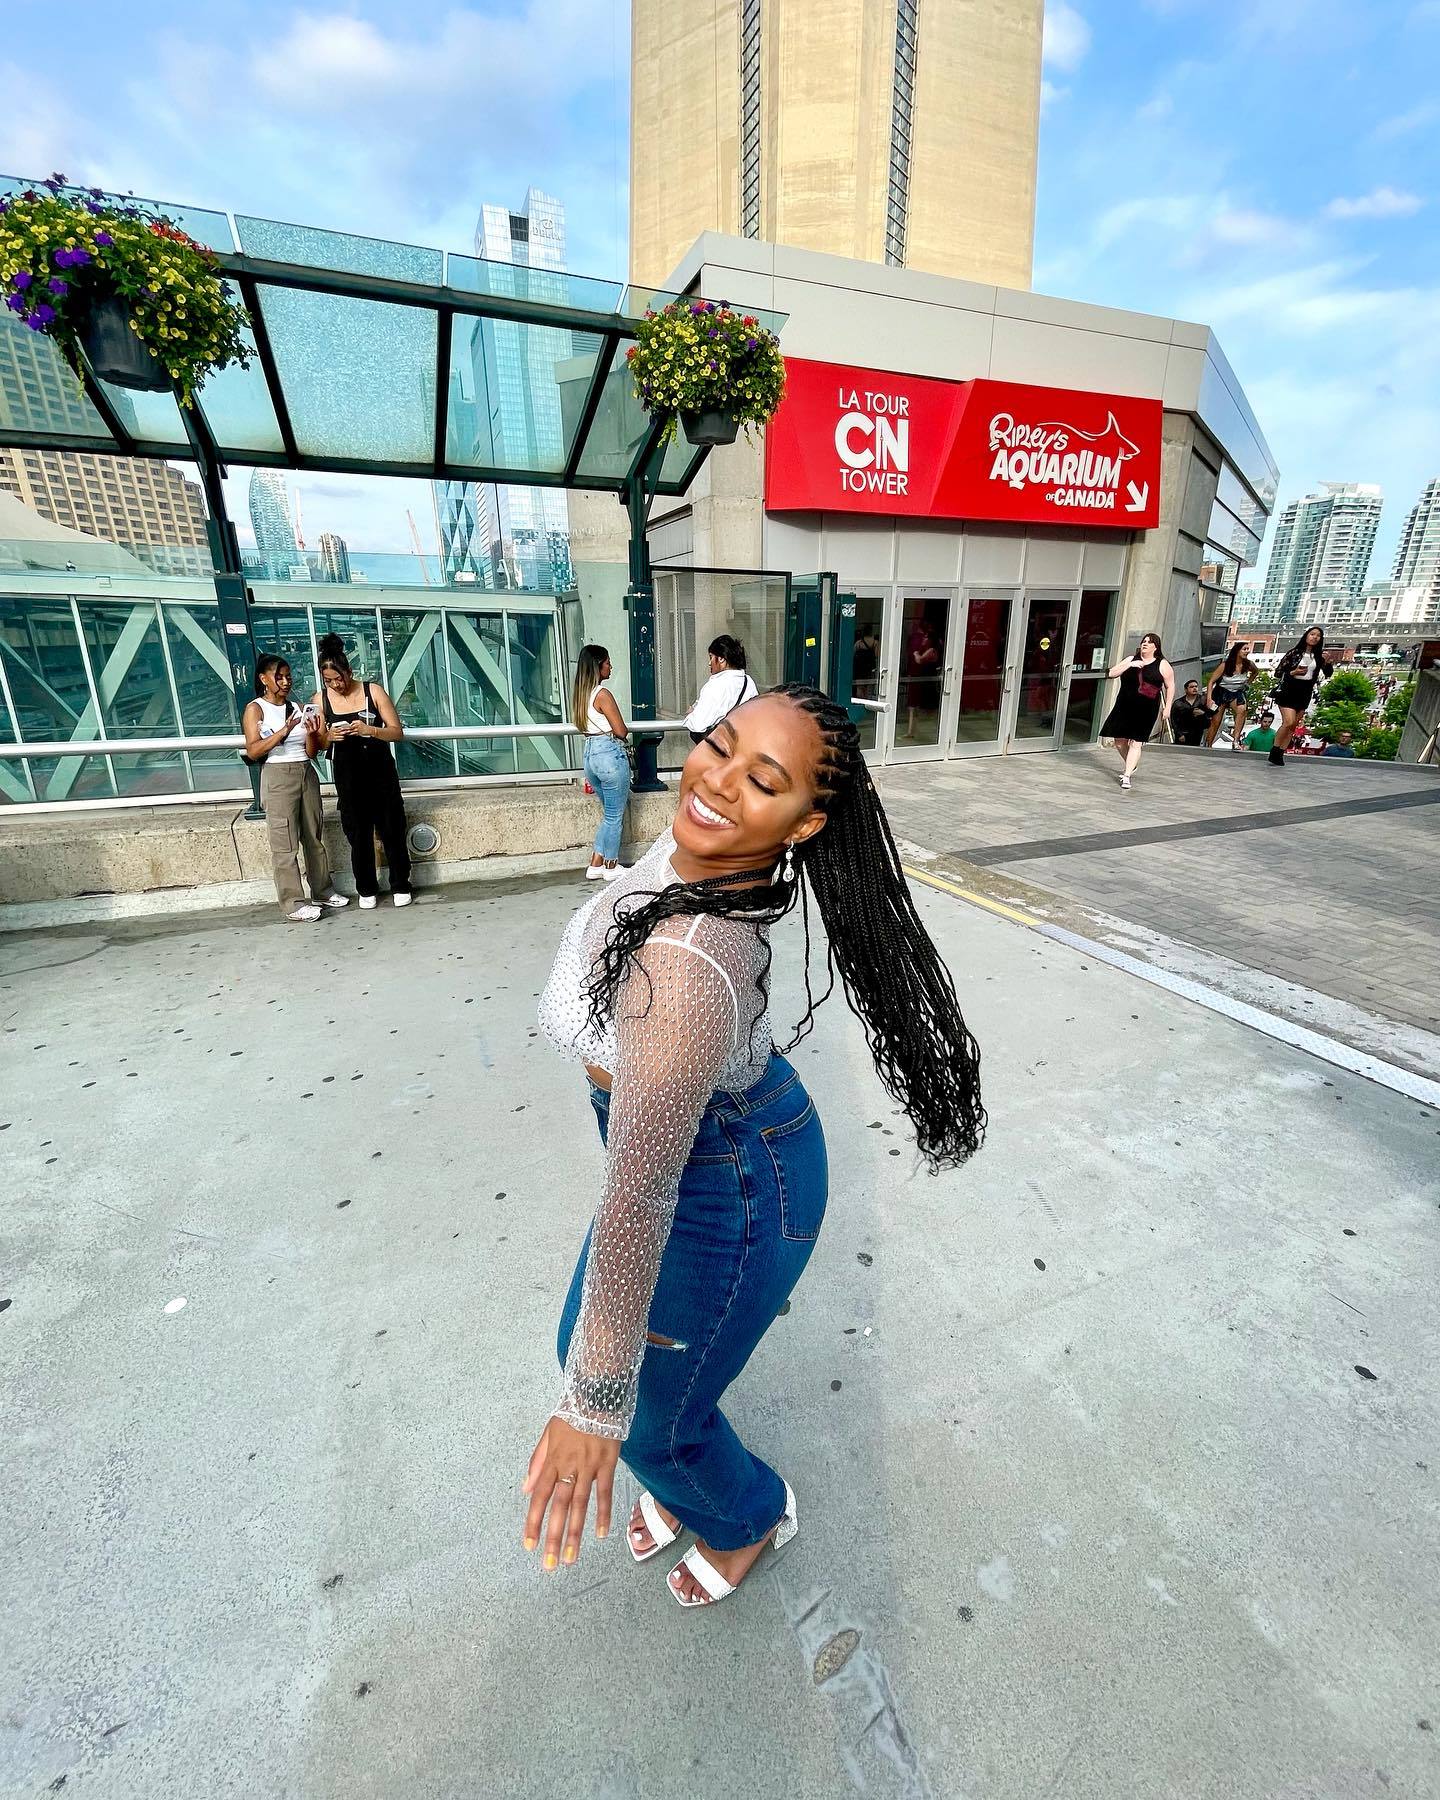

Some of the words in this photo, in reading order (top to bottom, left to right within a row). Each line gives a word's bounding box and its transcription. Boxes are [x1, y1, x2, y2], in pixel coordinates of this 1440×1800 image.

[532, 226, 562, 241] DELTA
[839, 387, 861, 410] LA
[864, 391, 909, 417] TOUR
[834, 411, 909, 472] CN
[839, 468, 909, 496] TOWER
[989, 449, 1121, 490] AQUARIUM
[1054, 487, 1115, 509] CANADA
